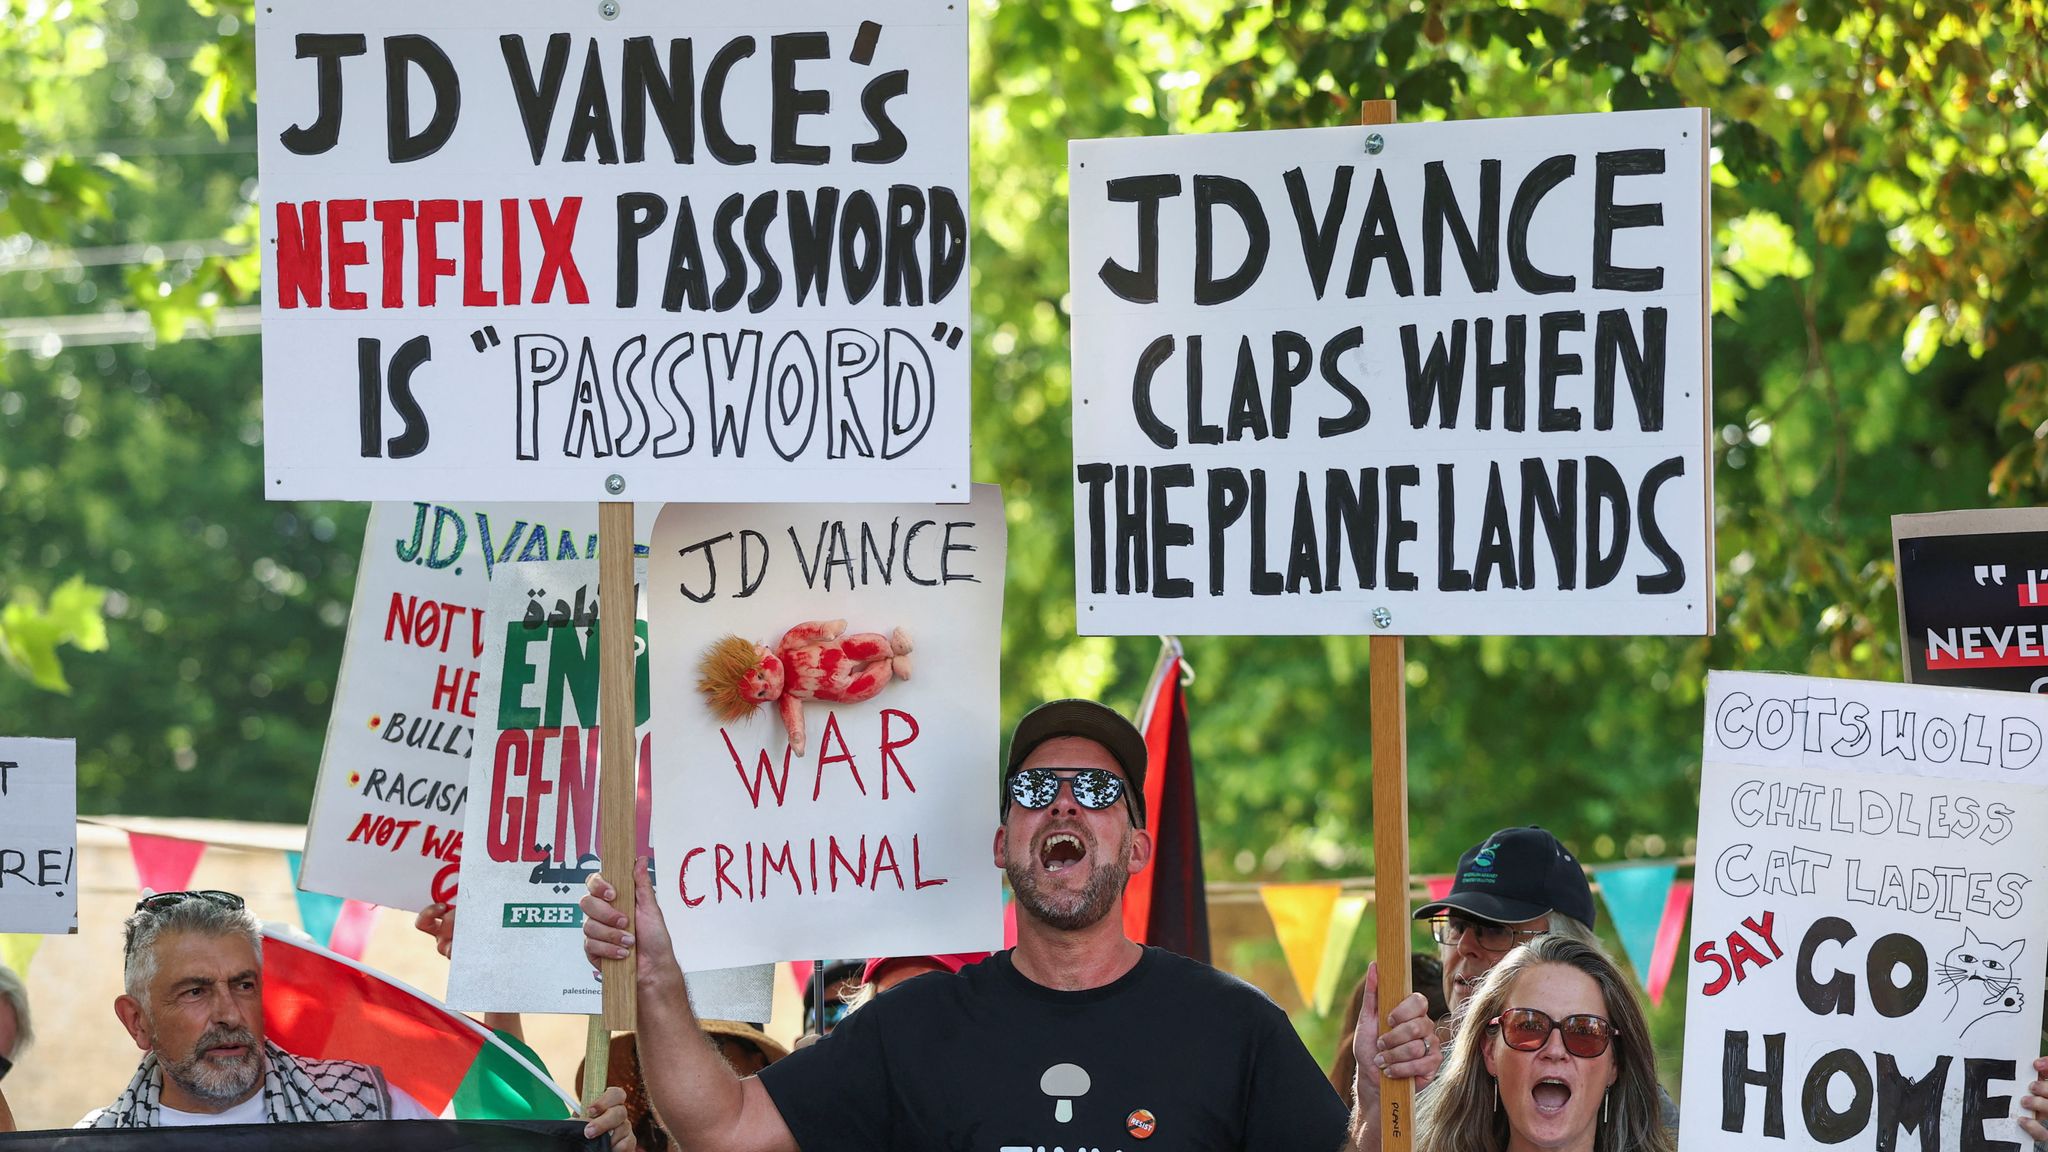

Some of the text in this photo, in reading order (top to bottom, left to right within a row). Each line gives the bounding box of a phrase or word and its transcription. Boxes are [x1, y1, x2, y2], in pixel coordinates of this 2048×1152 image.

[280, 21, 909, 165] JD VANCE's
[276, 186, 966, 313] NETFLIX PASSWORD
[1099, 149, 1666, 305] JD VANCE
[359, 322, 963, 461] IS "PASSWORD"
[1132, 307, 1667, 449] CLAPS WHEN
[679, 516, 981, 603] JD VANCE
[1077, 456, 1685, 597] THE PLANE LANDS
[385, 592, 466, 652] NOT
[1927, 625, 2048, 661] NEVE
[720, 709, 919, 809] WAR
[1715, 692, 2042, 770] COTSWOLD
[347, 813, 421, 852] NOT
[487, 725, 654, 863] GEN
[1731, 780, 2014, 845] CHILDLESS
[679, 834, 948, 908] CRIMINAL
[1715, 843, 2032, 921] CAT LADIES
[510, 907, 574, 923] FREE
[1695, 911, 1928, 1018] SAY GO
[1130, 1117, 1153, 1131] RESIST
[1391, 1102, 1401, 1138] PLANE
[1722, 1028, 2022, 1152] HOME
